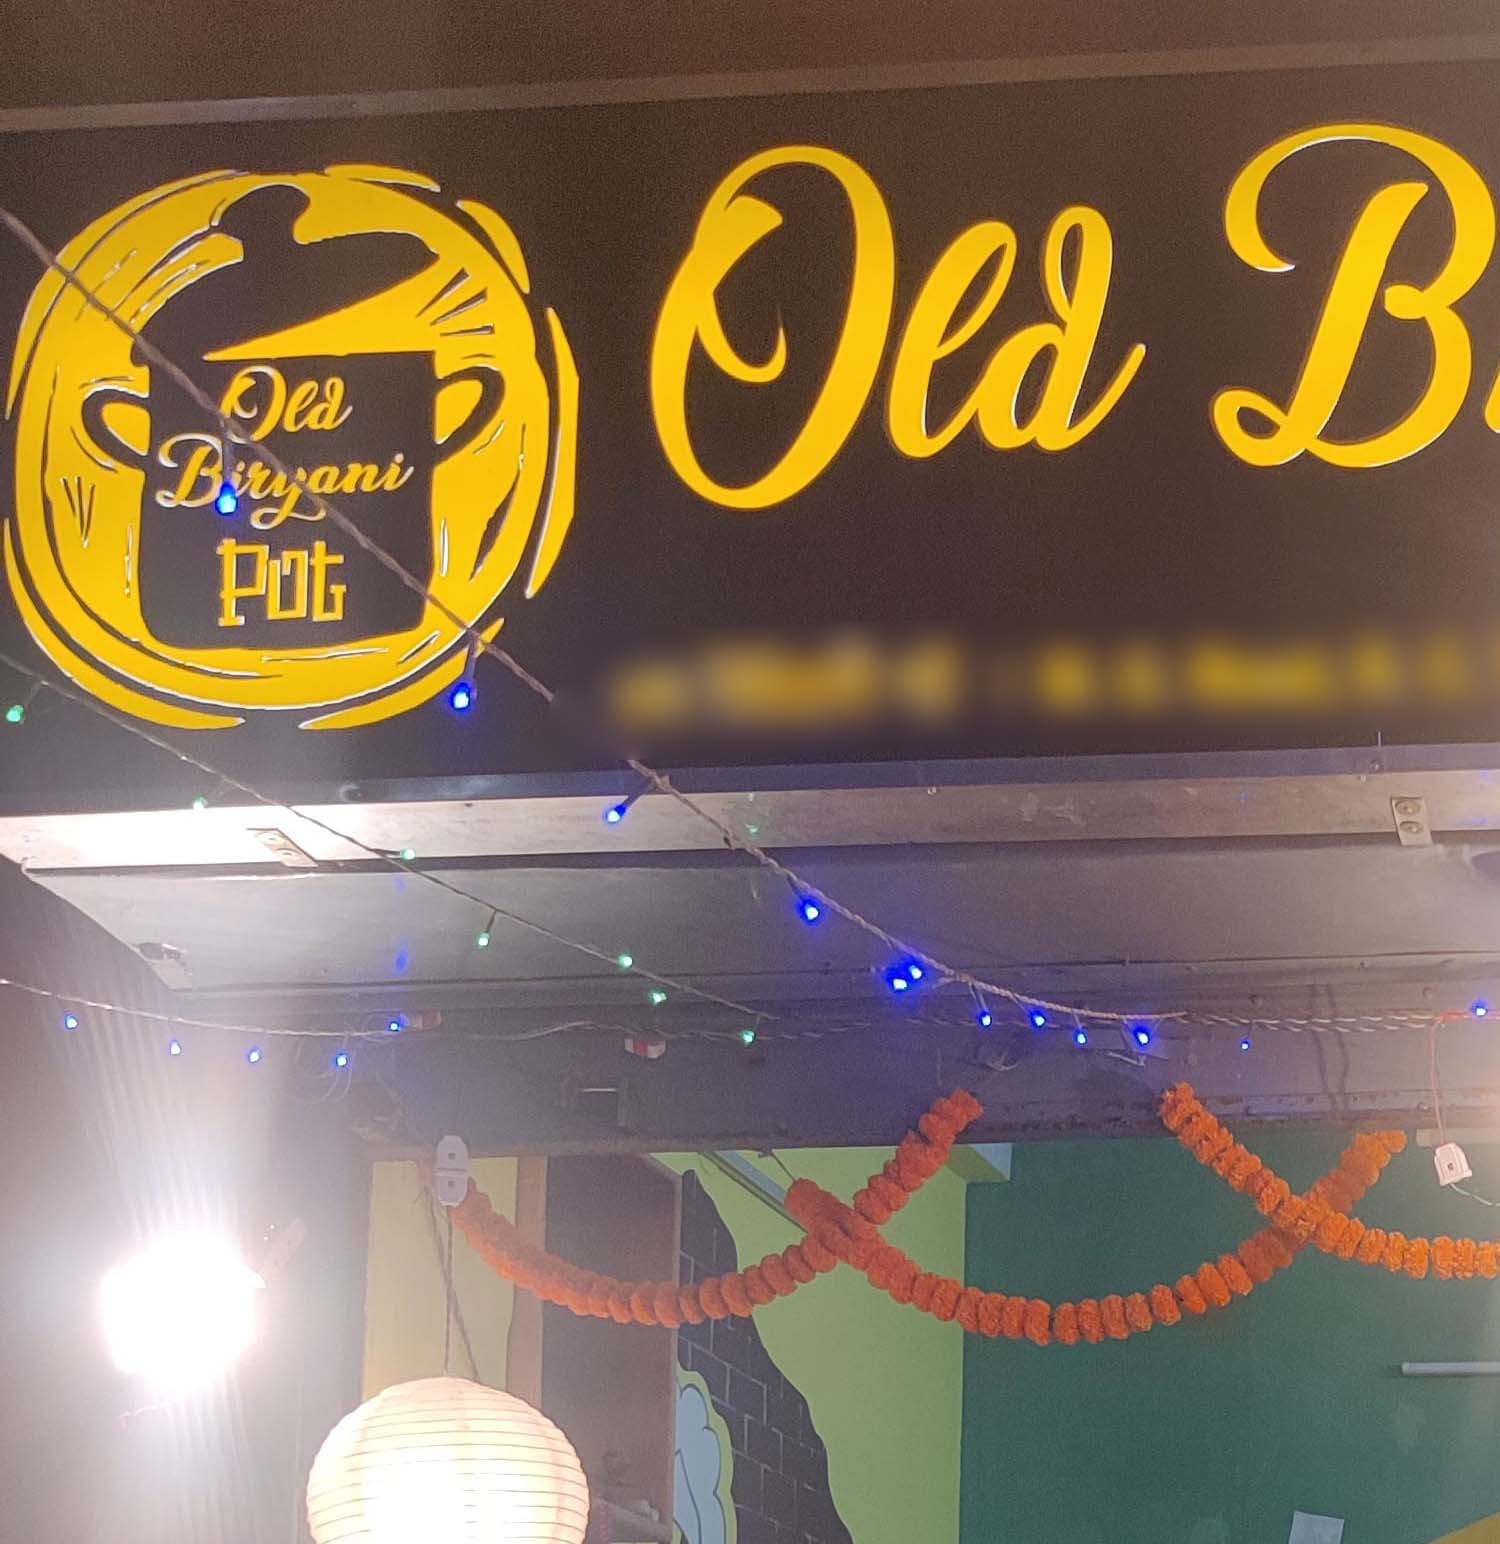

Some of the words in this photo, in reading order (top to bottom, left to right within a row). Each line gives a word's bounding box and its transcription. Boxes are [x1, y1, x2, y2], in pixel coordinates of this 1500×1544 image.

[650, 145, 1146, 512] Old
[218, 365, 353, 444] Old
[155, 433, 414, 530] Biryani
